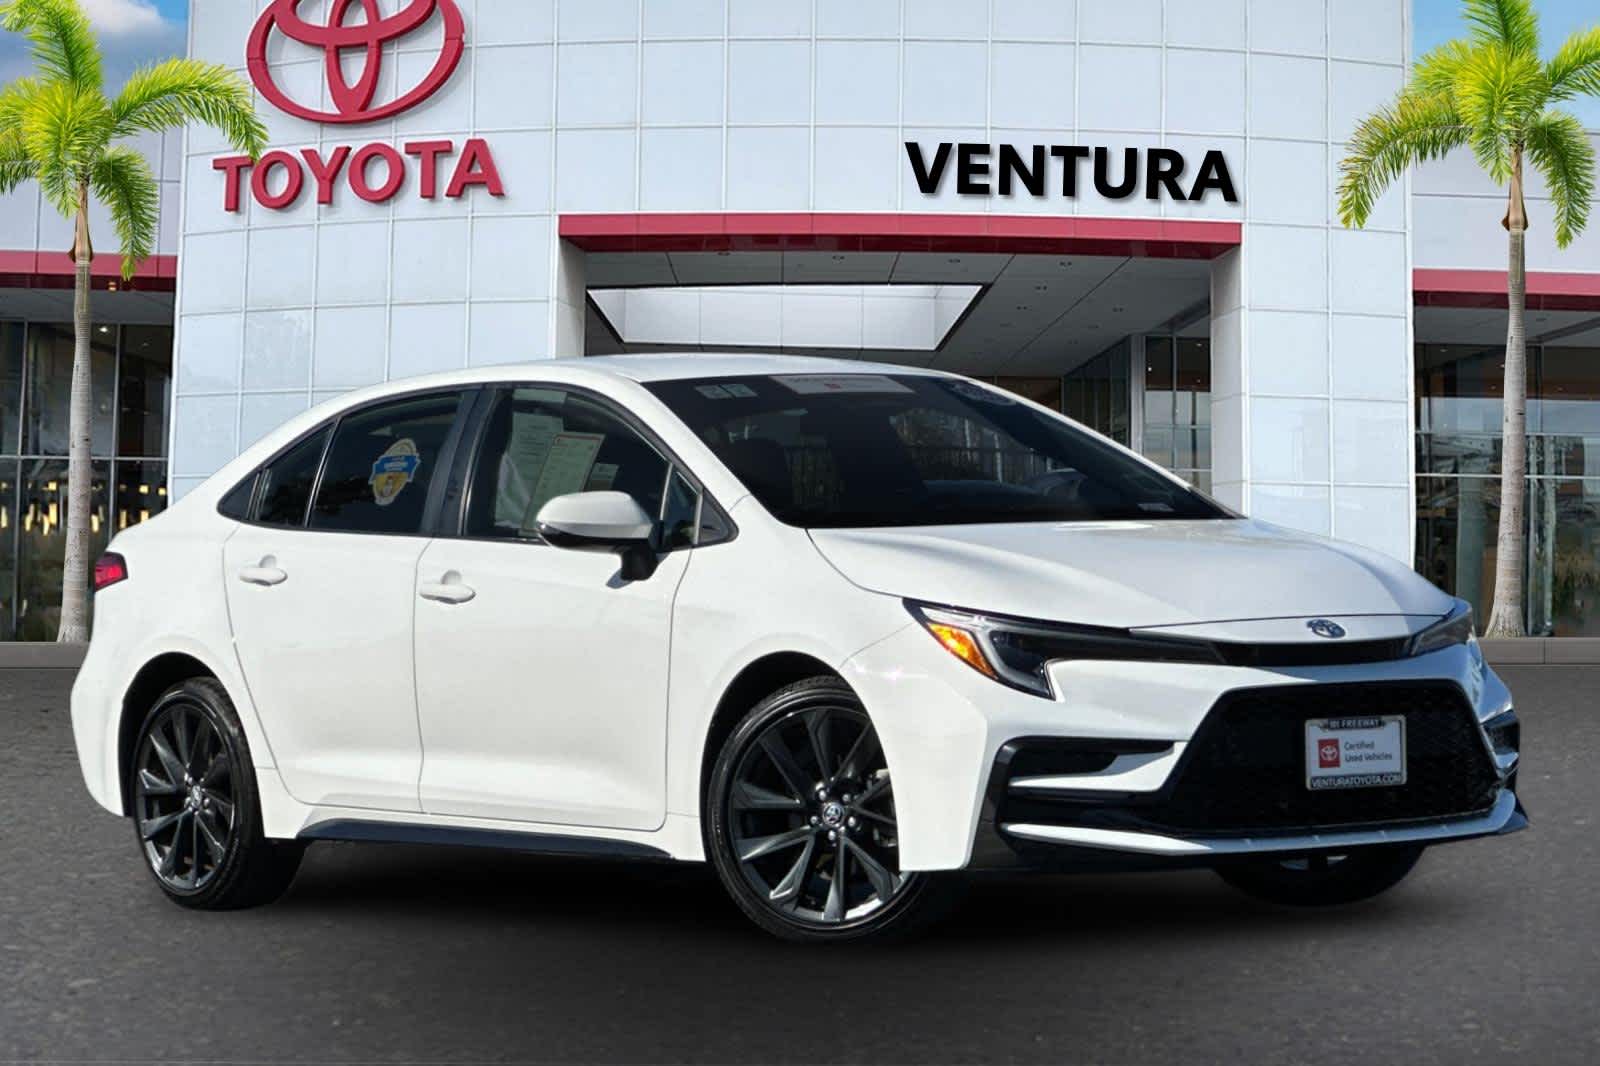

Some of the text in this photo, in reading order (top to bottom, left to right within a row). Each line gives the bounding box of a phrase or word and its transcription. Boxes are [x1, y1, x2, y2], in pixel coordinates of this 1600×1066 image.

[214, 139, 505, 212] TOYOTA
[905, 142, 1238, 203] VENTURA
[1344, 741, 1375, 750] Certified
[1345, 752, 1393, 762] Used Vehicles
[1312, 775, 1402, 788] VENTURATOYOTA.COM
